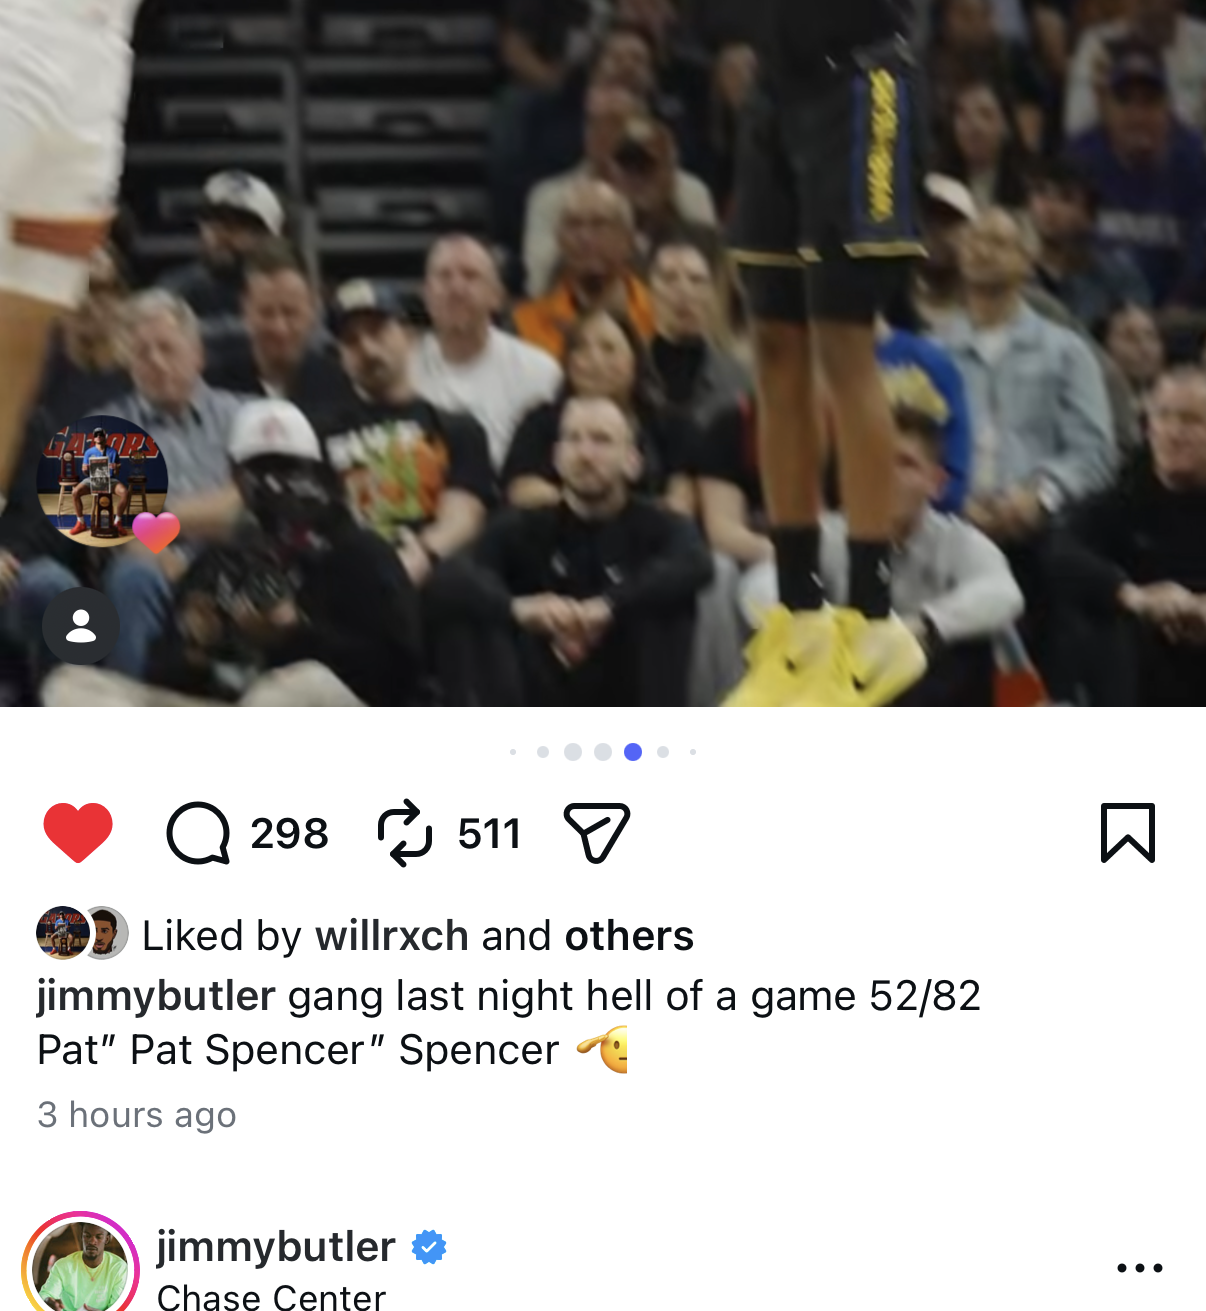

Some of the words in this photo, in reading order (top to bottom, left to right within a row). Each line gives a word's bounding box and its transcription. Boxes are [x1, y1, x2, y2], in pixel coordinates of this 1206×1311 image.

[43, 426, 160, 460] GAORS
[252, 817, 329, 850] 298
[459, 817, 519, 850] 511
[145, 919, 242, 951] Liked
[258, 919, 301, 958] by
[315, 918, 467, 951] willrxch
[483, 919, 550, 951] and
[566, 919, 693, 951] others
[36, 978, 276, 1018] jimmybutler
[289, 987, 382, 1018] gang
[398, 979, 463, 1011] last
[479, 979, 572, 1018] night
[588, 979, 650, 1011] hell
[667, 979, 703, 1011] of
[717, 987, 735, 1011] a
[752, 987, 855, 1018] game
[871, 979, 980, 1018] 52/82
[133, 1034, 191, 1065] Pat
[400, 1033, 559, 1072] Spencer
[38, 1100, 57, 1127] 3
[71, 1100, 162, 1127] hours
[176, 1108, 236, 1135] ago
[156, 1229, 396, 1269] jimmybutler
[158, 1284, 260, 1311] Chase
[274, 1285, 386, 1311] Center
